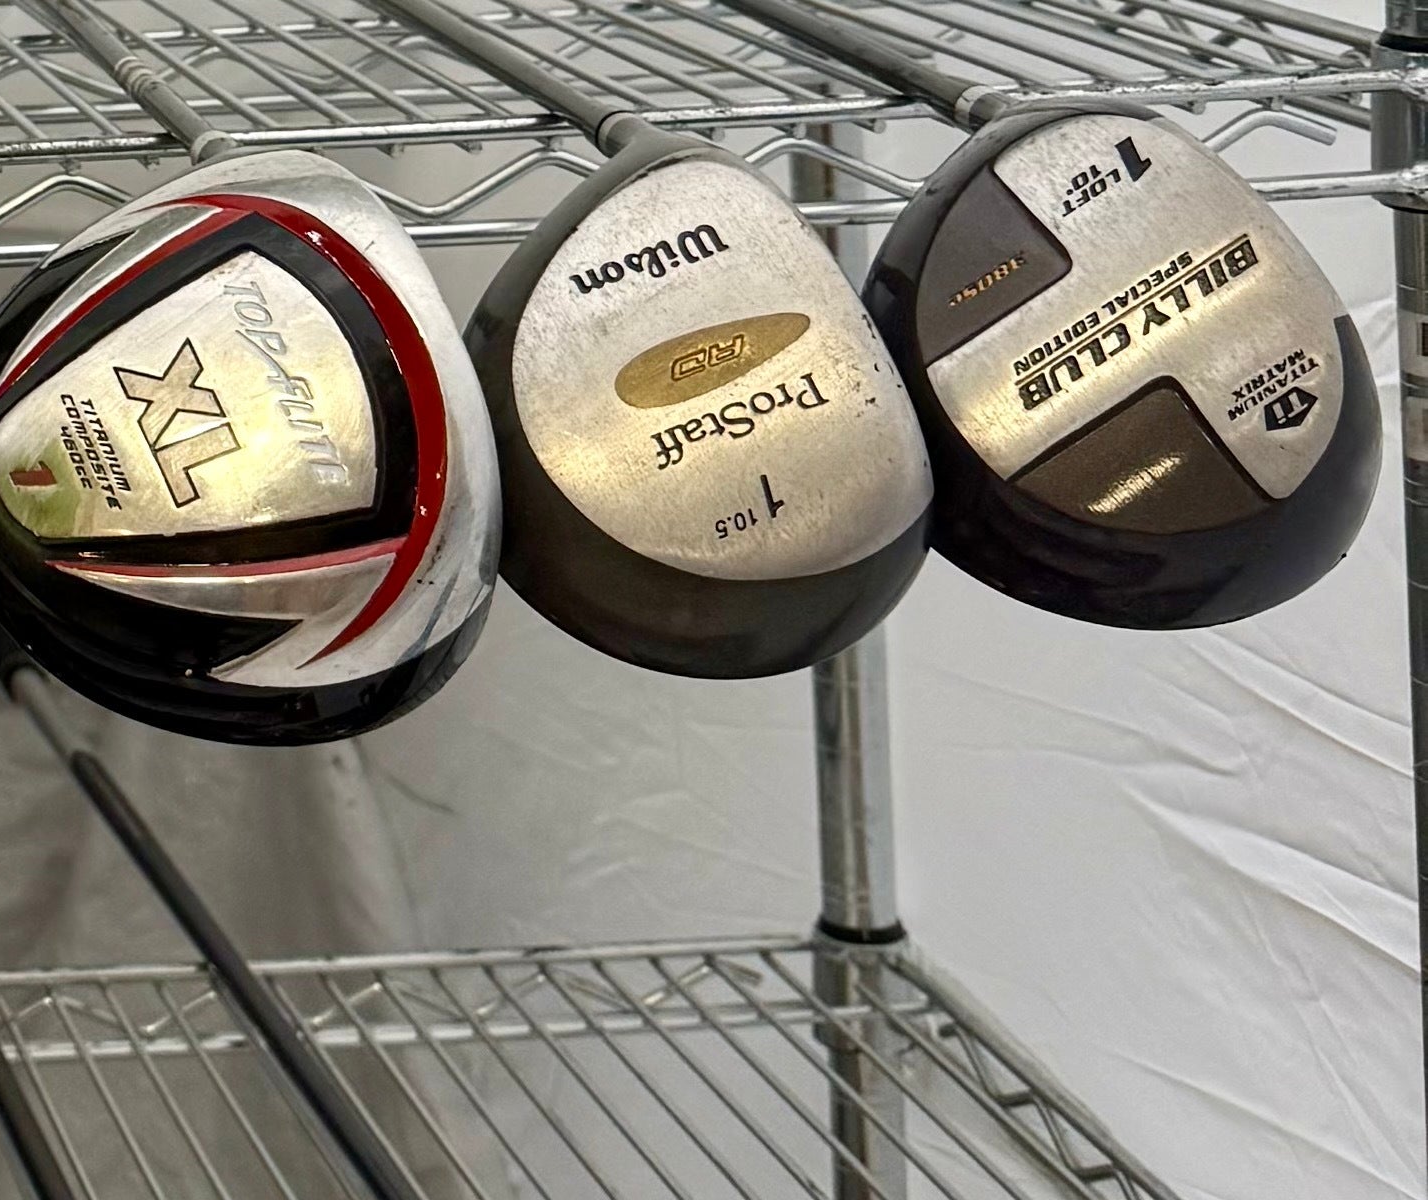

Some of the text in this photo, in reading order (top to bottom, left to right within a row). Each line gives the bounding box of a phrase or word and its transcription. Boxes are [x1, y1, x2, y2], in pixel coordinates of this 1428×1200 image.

[1061, 136, 1152, 218] 1 LOFT
[569, 223, 730, 297] Wilson
[1013, 251, 1194, 376] SPECIAL EDITION
[1017, 238, 1260, 412] BILLY CLUB
[1227, 357, 1319, 422] TITANIUM
[1231, 348, 1306, 402] MATRIX
[1276, 390, 1311, 426] Ti
[59, 393, 123, 511] COMPOSITE
[62, 424, 94, 489] 460cc
[84, 398, 133, 494] TITANIUM
[113, 337, 242, 509] XL
[650, 373, 830, 471] ProStaff
[9, 460, 57, 489] 1
[714, 474, 786, 540] 1 10.5
